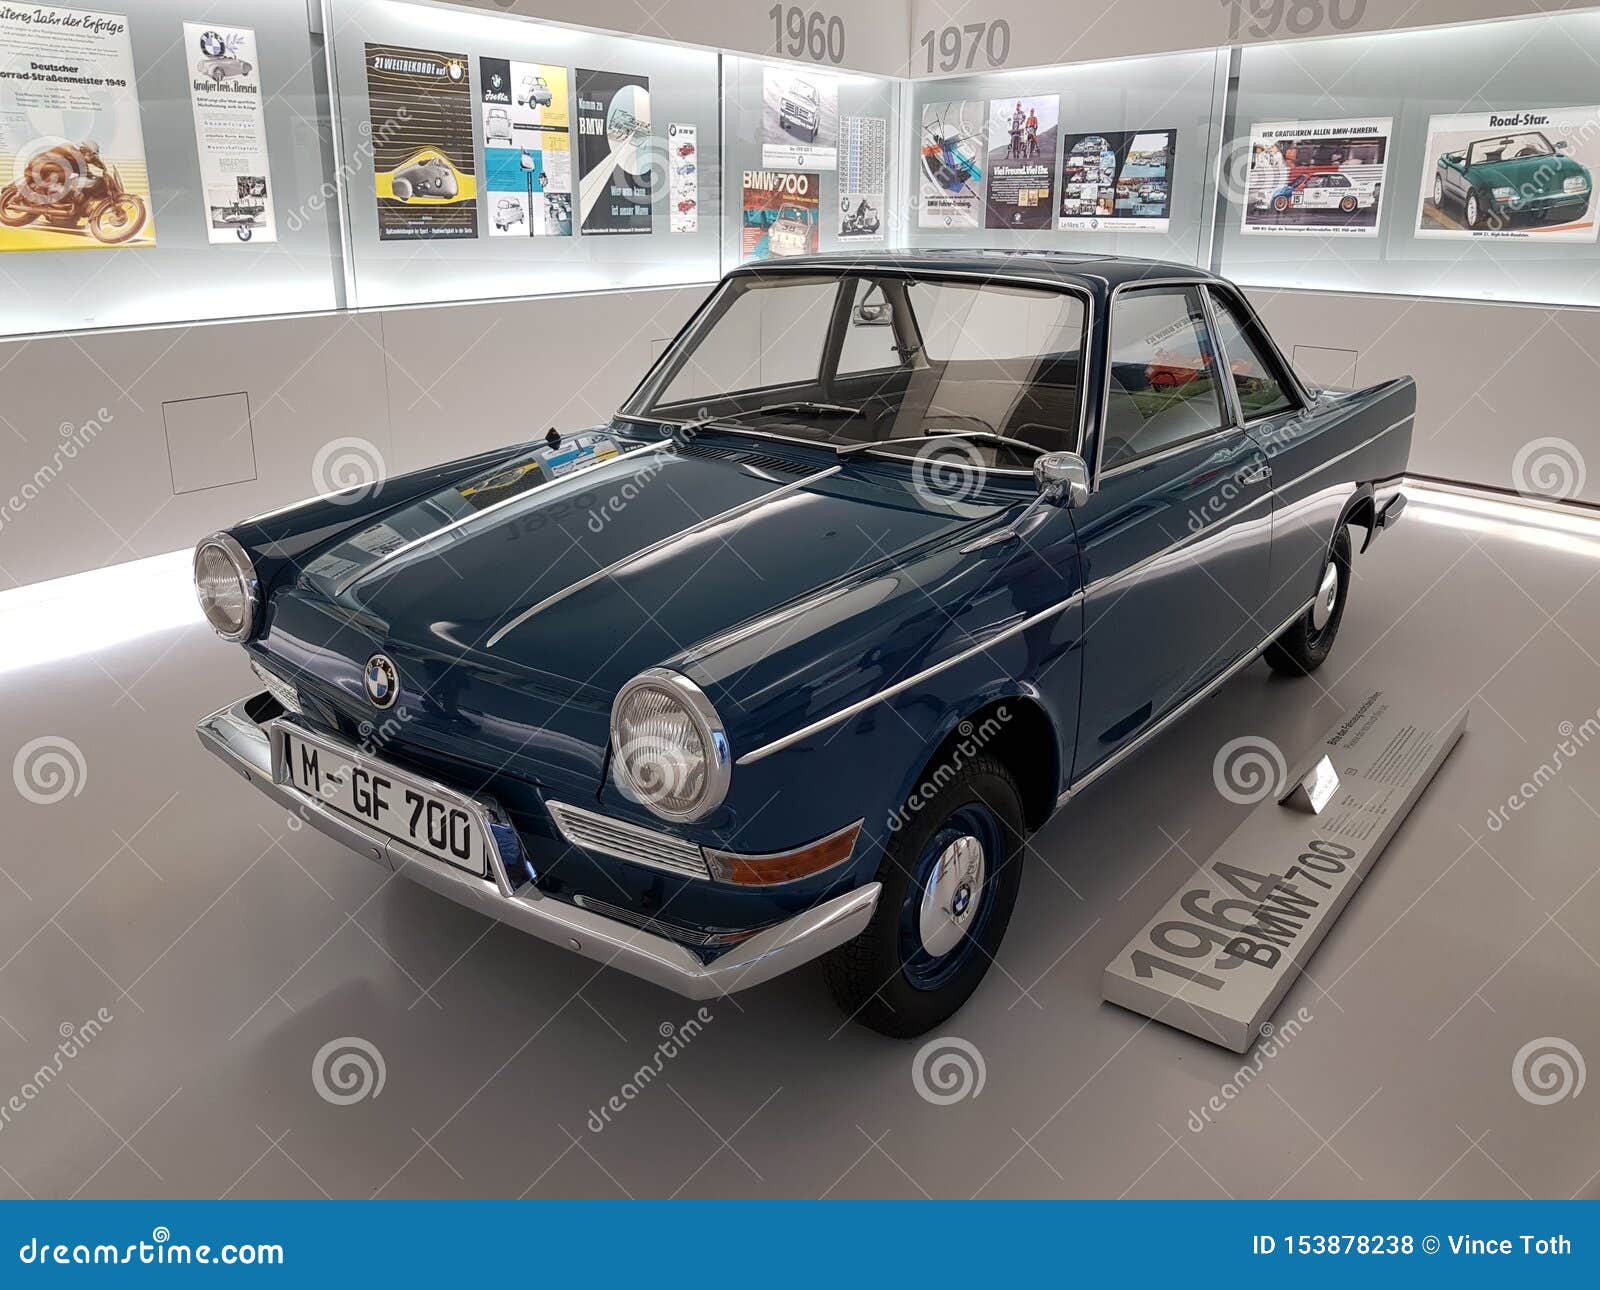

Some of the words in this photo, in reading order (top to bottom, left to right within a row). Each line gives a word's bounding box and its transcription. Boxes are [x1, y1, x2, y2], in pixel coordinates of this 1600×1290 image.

[0, 6, 32, 24] iteres
[33, 9, 59, 25] Jahr
[62, 14, 82, 28] der
[83, 15, 125, 36] Erfolge
[769, 4, 845, 64] 1960
[921, 19, 1011, 73] 1970
[30, 62, 79, 73] Deutscher
[374, 57, 384, 69] 21
[384, 58, 436, 74] WELTREKORDE
[105, 79, 127, 87] 1949
[579, 117, 604, 136] BMW
[1489, 113, 1550, 127] Road-Star.
[1275, 129, 1311, 137] GRATULIEREN
[1313, 128, 1331, 136] ALLEN
[1332, 126, 1379, 135] BMW-FAHRERN.
[993, 166, 1005, 175] Viel
[777, 174, 808, 195] 700
[405, 789, 471, 860] 700
[1222, 882, 1320, 971] BMW
[1282, 839, 1357, 890] 700
[1130, 861, 1284, 992] 1964
